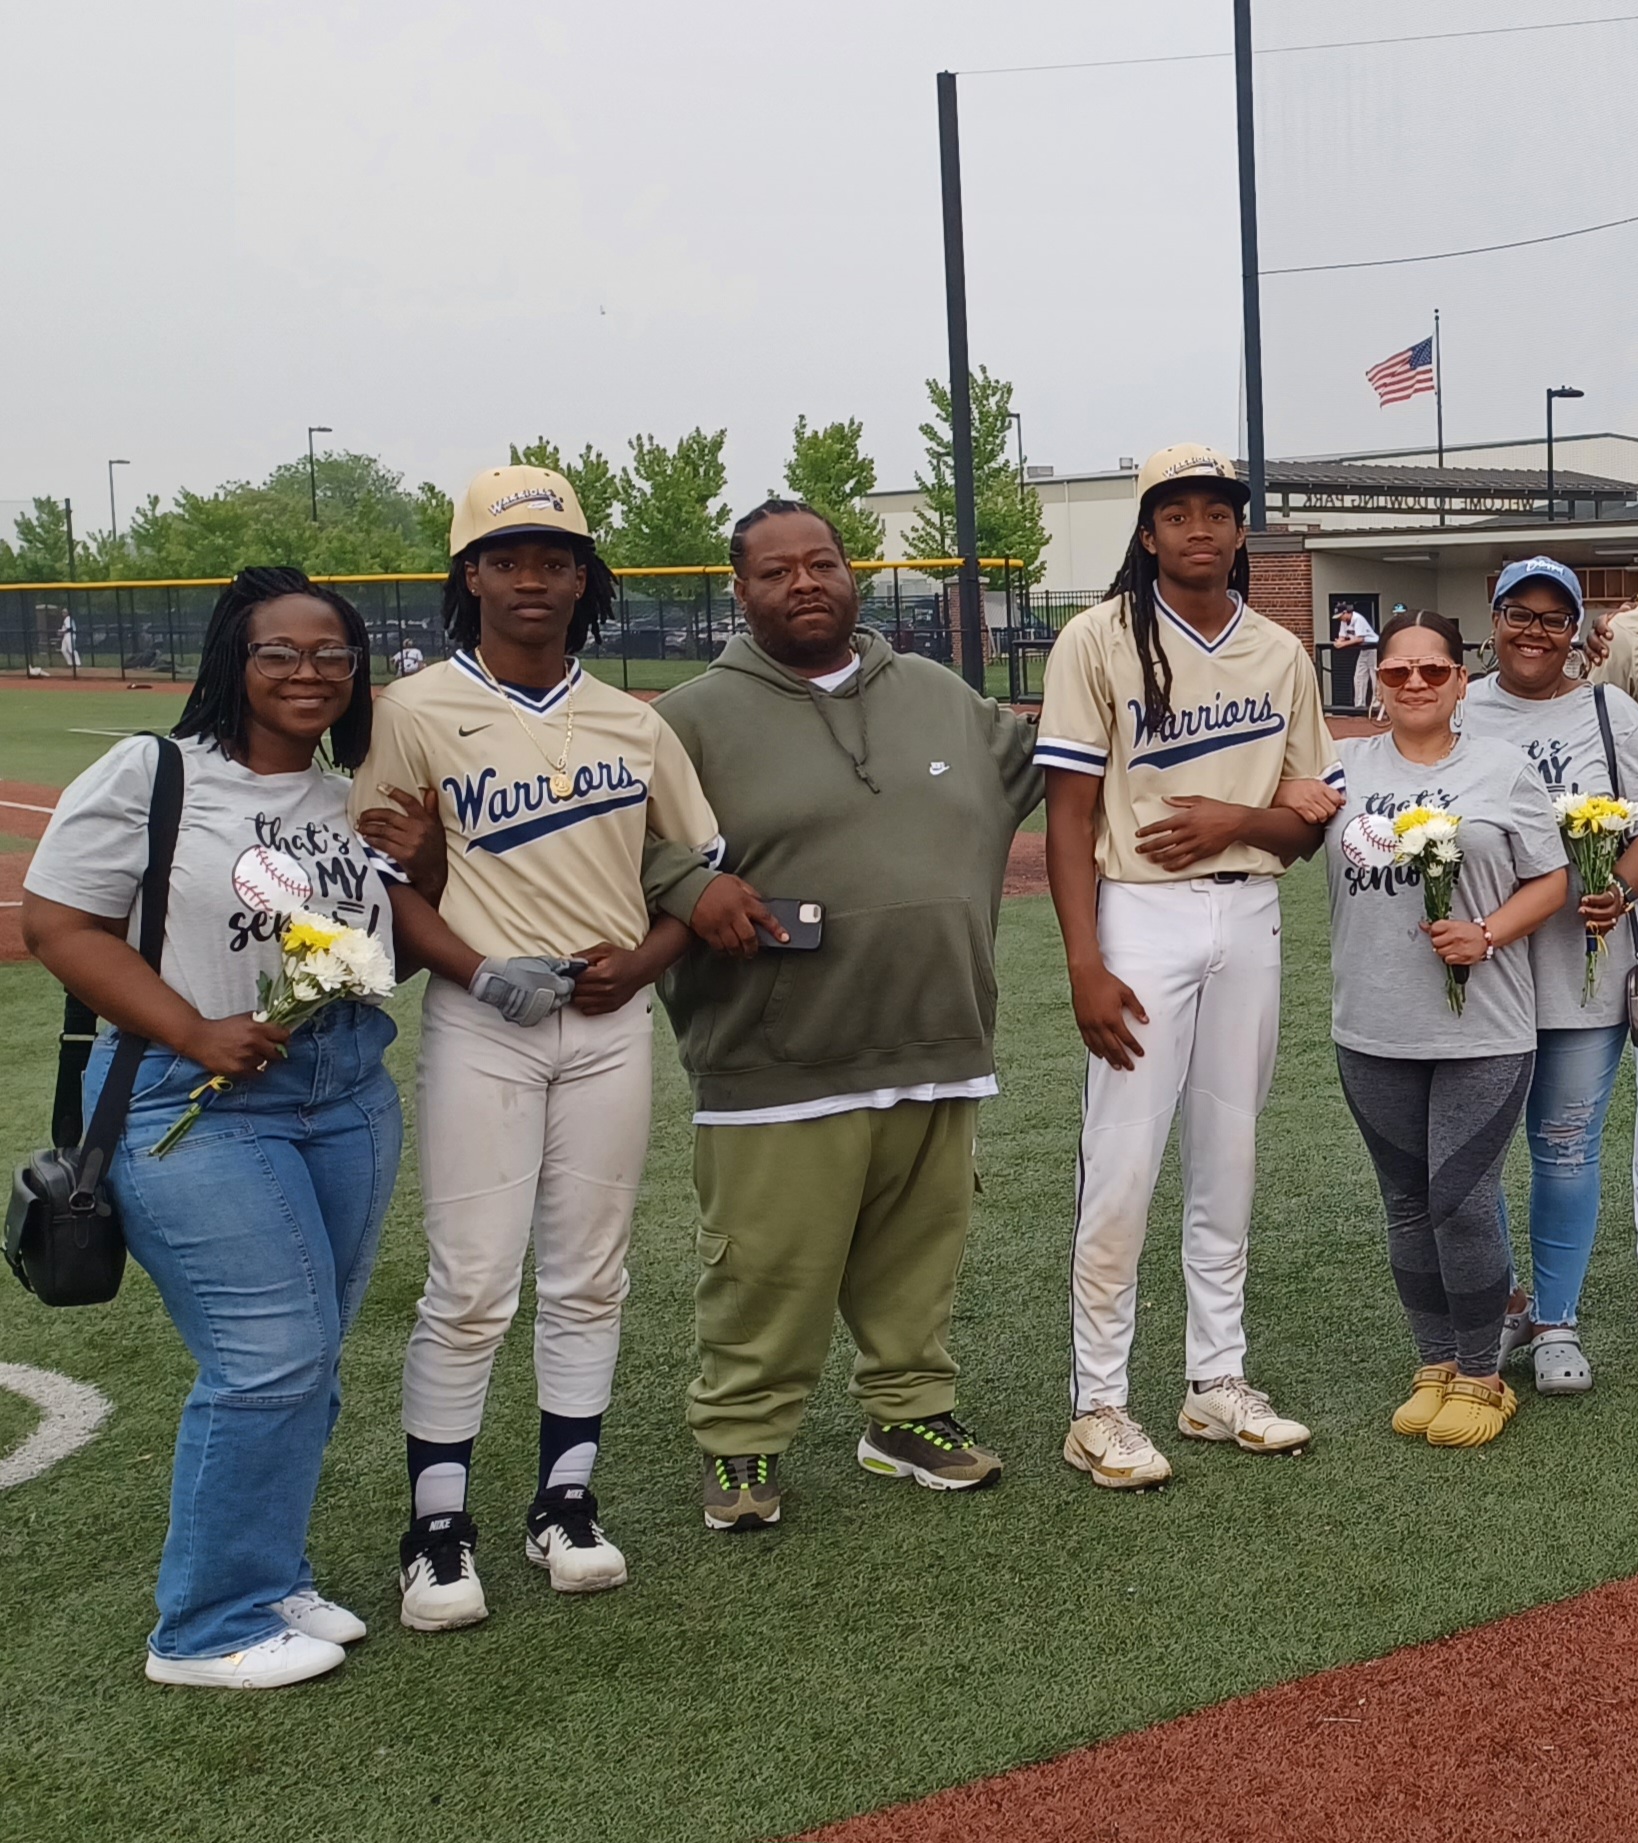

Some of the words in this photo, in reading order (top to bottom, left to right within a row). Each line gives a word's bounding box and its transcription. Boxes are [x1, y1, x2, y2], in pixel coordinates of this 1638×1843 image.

[1127, 691, 1286, 750] Warriors
[244, 811, 350, 861] that's
[315, 856, 368, 902] MY
[564, 1489, 585, 1500] NIKE
[428, 1517, 452, 1532] NIKE
